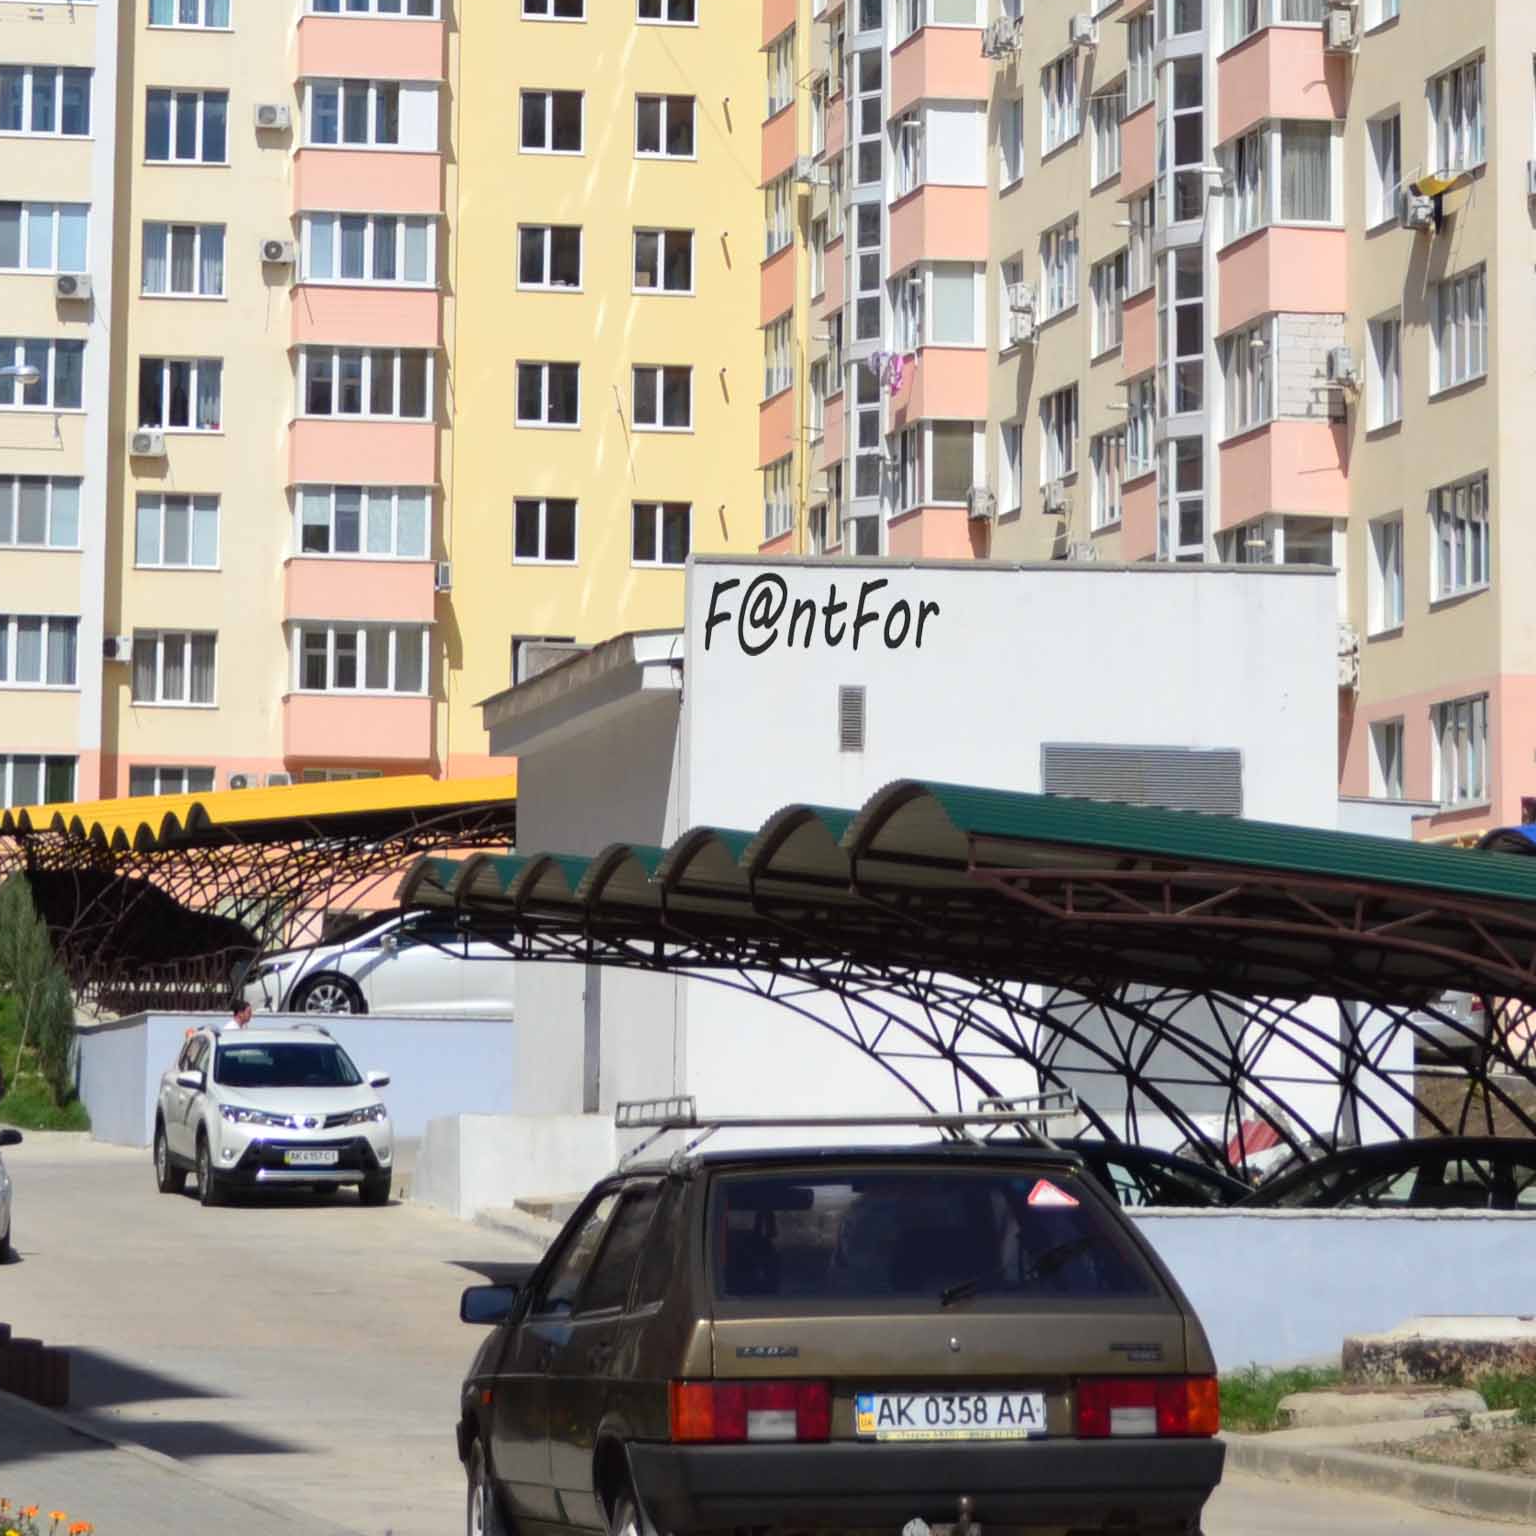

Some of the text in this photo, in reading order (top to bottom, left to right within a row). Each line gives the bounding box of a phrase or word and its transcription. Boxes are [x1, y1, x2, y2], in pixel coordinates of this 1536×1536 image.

[877, 1395, 1037, 1426] AK 0358 AA
